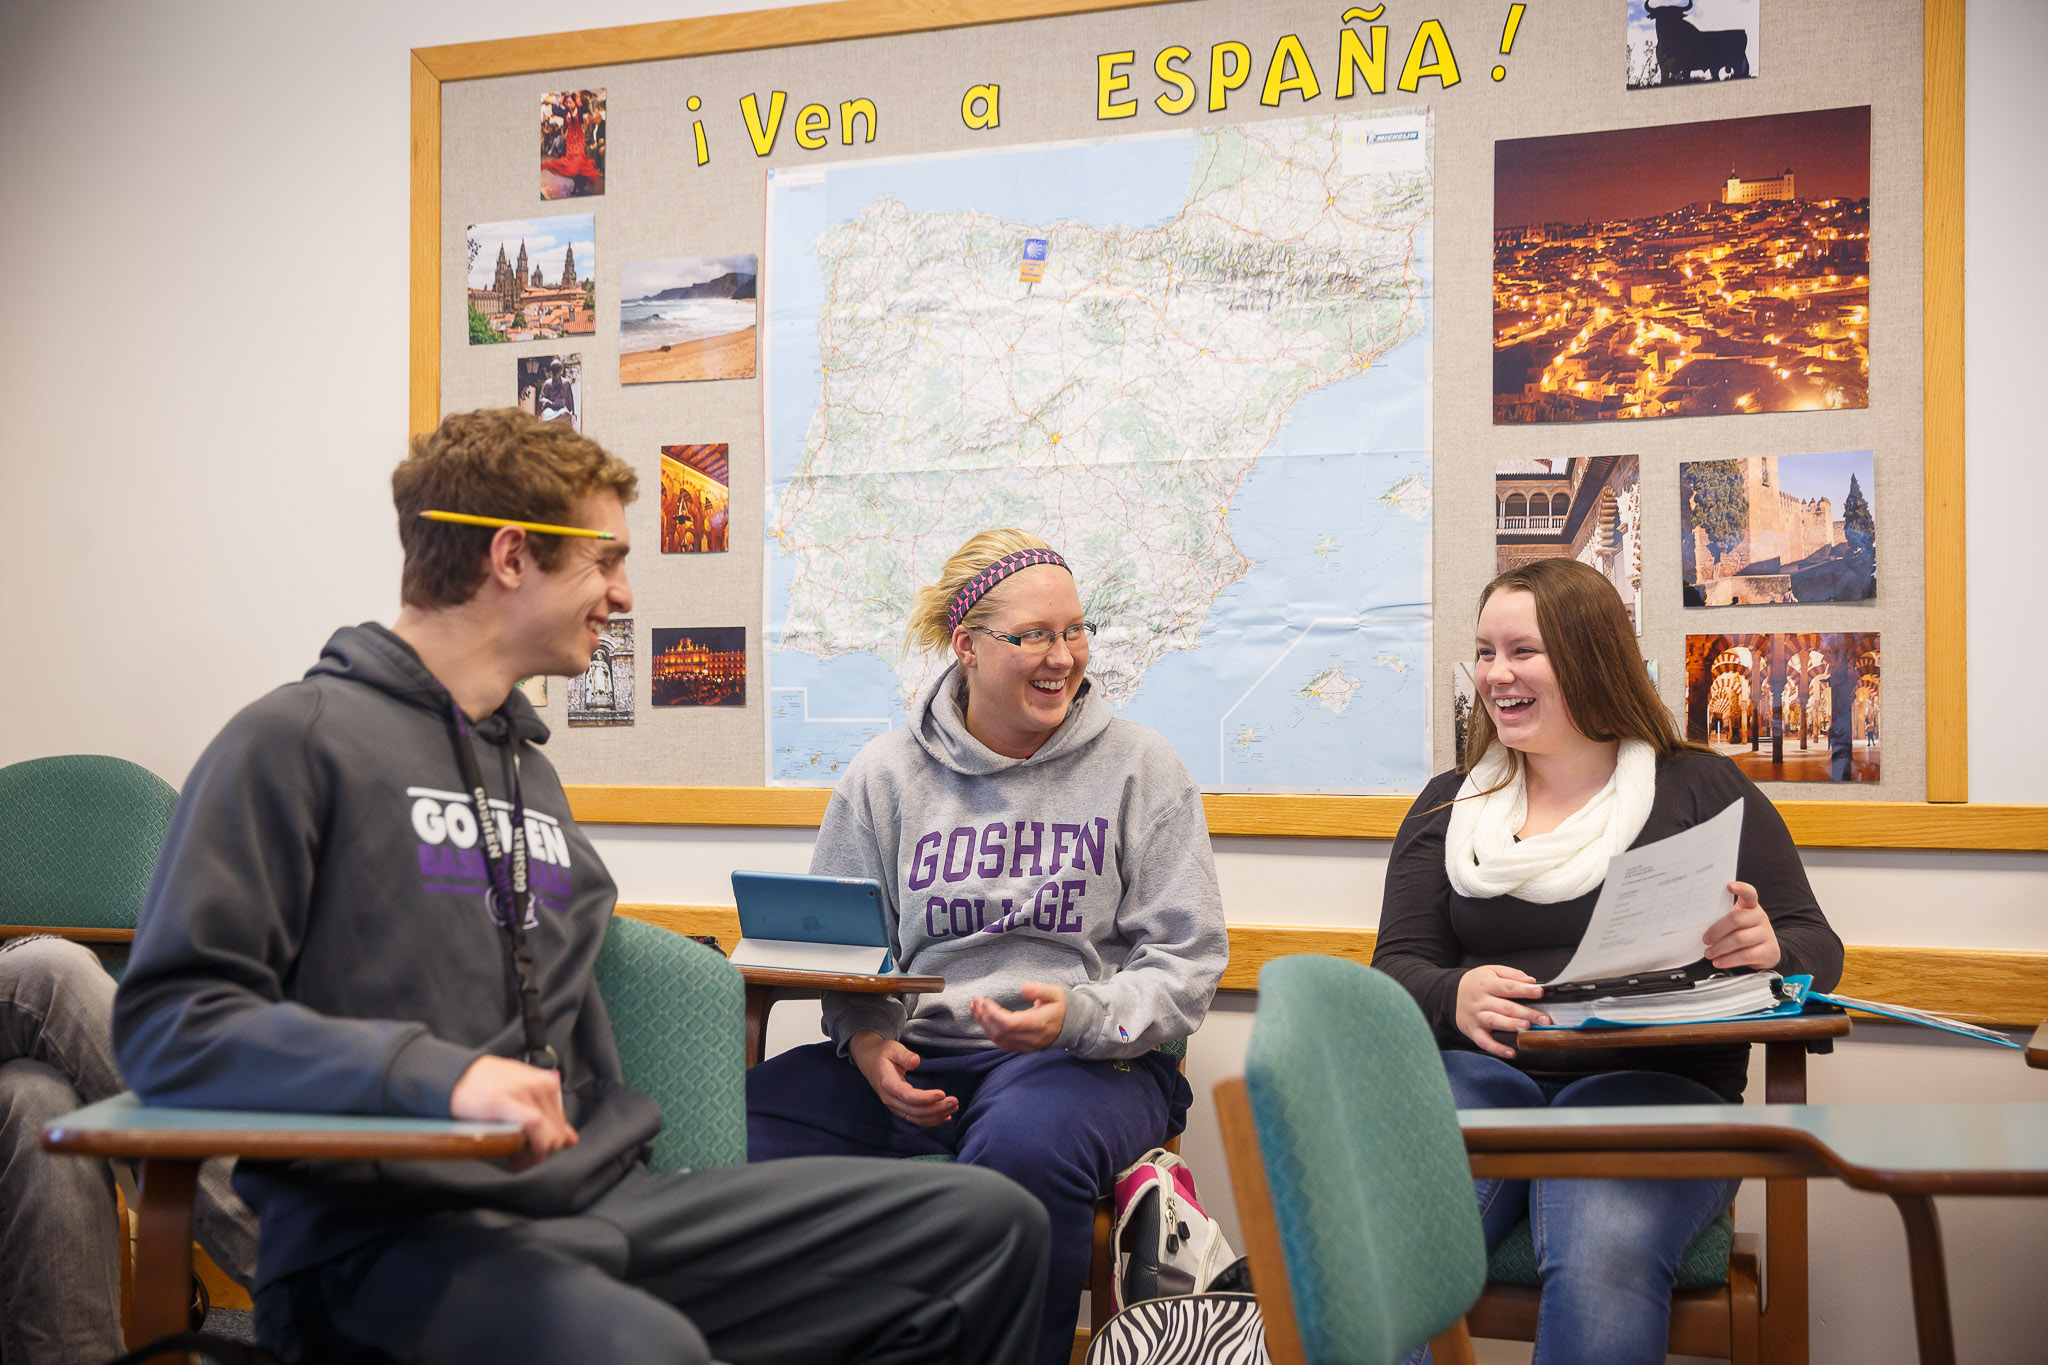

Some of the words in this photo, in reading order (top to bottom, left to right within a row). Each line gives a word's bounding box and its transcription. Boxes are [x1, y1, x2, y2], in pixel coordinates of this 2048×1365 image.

[961, 83, 1001, 130] a
[1375, 131, 1418, 142] MICHELIN
[512, 827, 528, 893] GOSHEN
